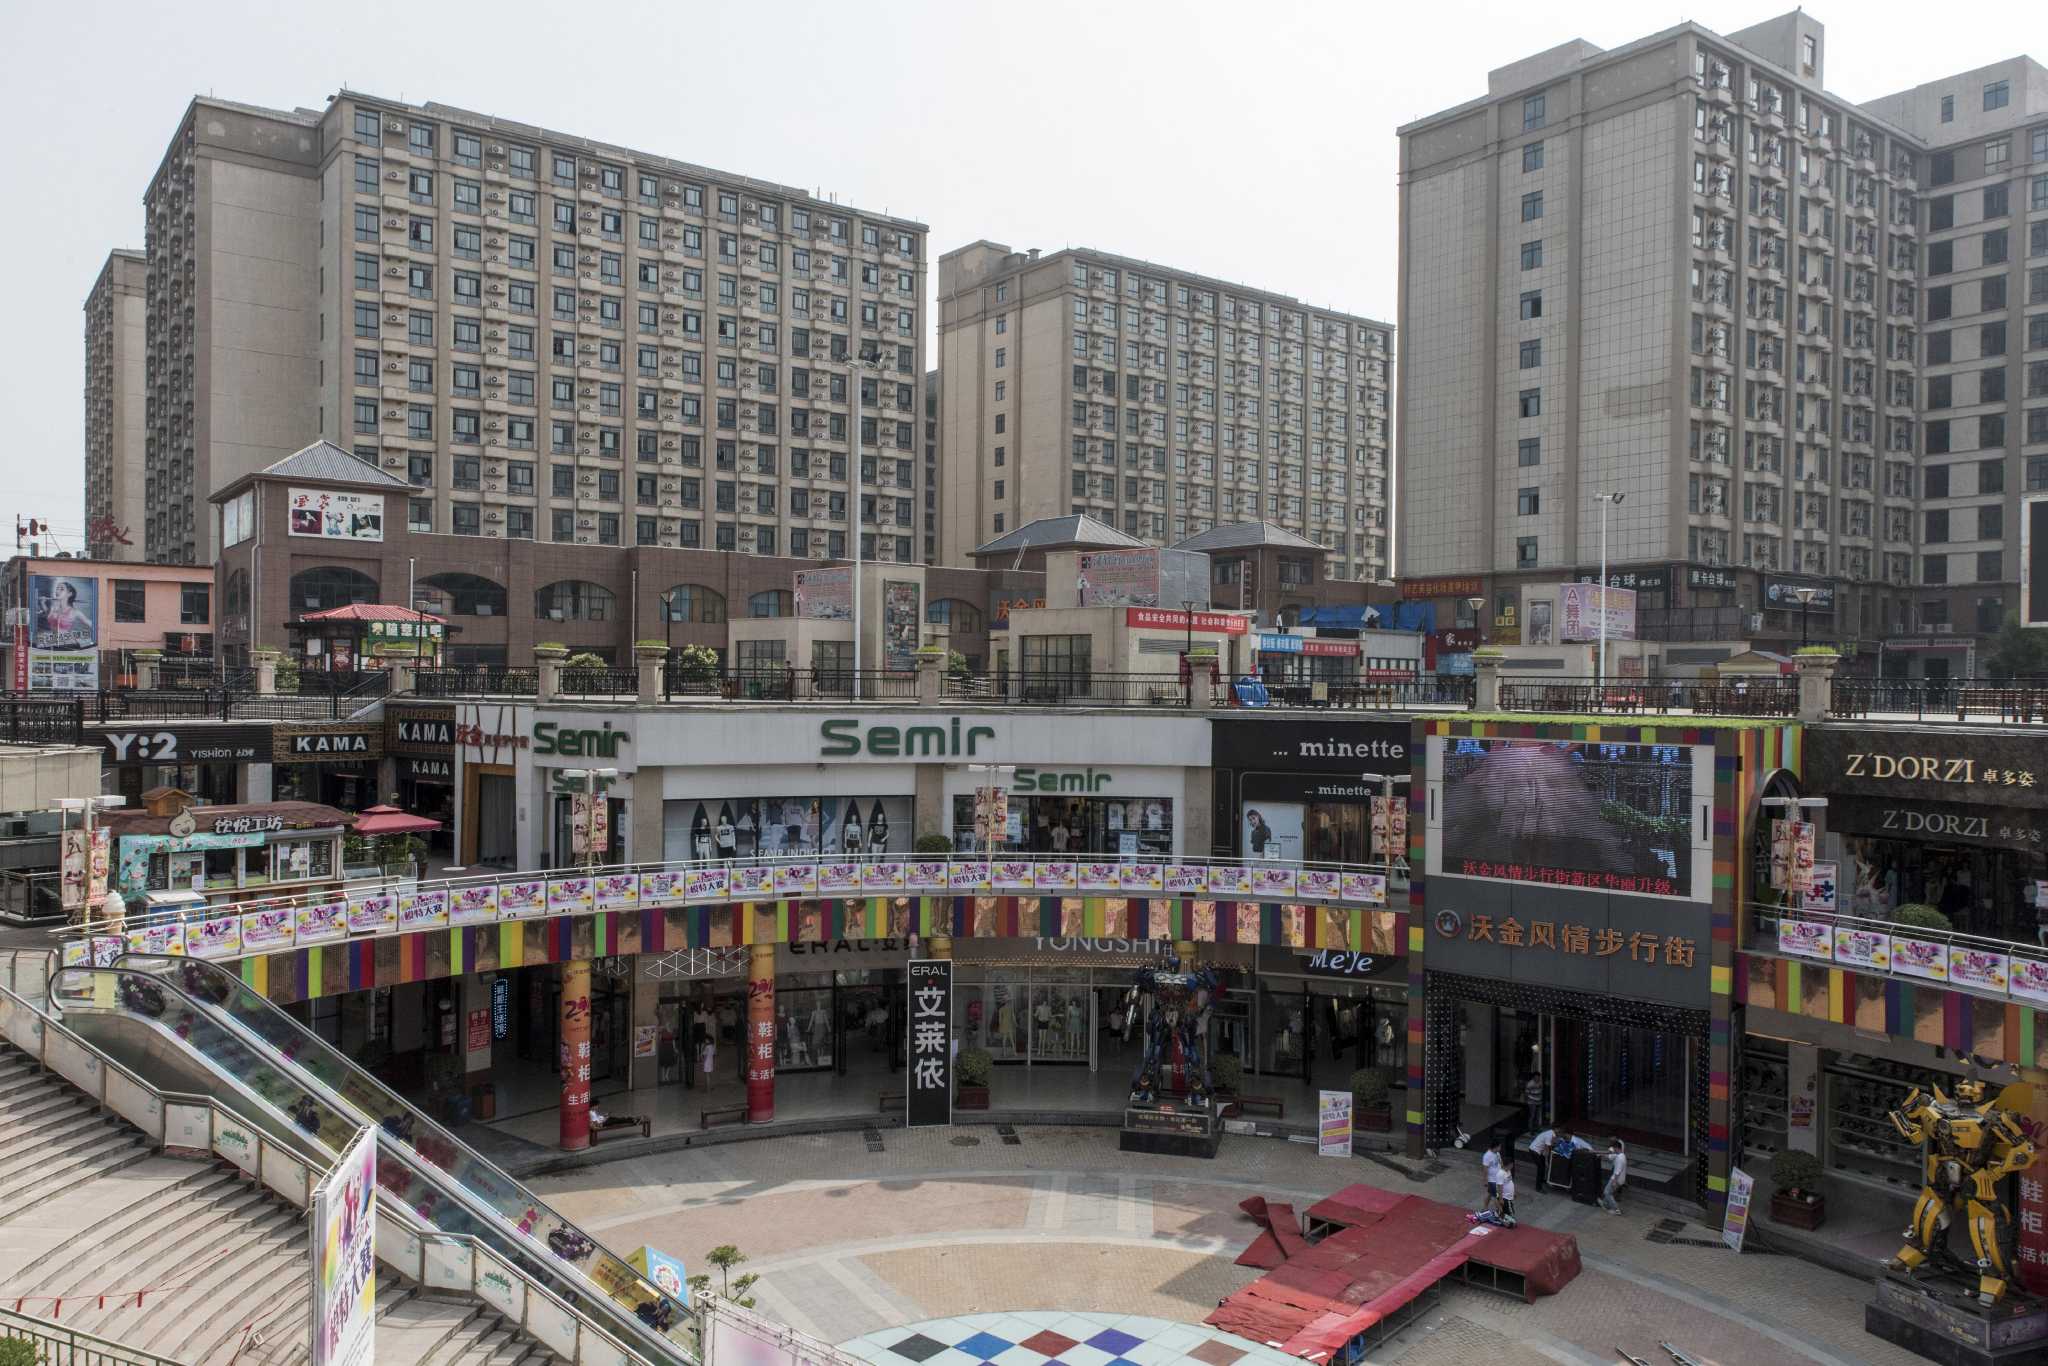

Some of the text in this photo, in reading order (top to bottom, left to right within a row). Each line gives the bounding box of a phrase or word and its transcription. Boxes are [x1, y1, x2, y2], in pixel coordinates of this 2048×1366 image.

[399, 722, 449, 743] KAMA
[533, 720, 632, 758] Semir
[819, 716, 996, 756] Semir
[296, 735, 369, 752] KAMA
[1299, 738, 1404, 759] minette
[411, 760, 449, 776] KAMA
[1982, 768, 2037, 788] 卓多姿
[1012, 767, 1113, 792] Semir
[1318, 784, 1372, 796] minette
[1466, 912, 1697, 969] 沃金风情步行街
[911, 966, 948, 977] ERAL
[914, 987, 946, 1090] 艾莱依
[567, 1093, 591, 1106] 生活
